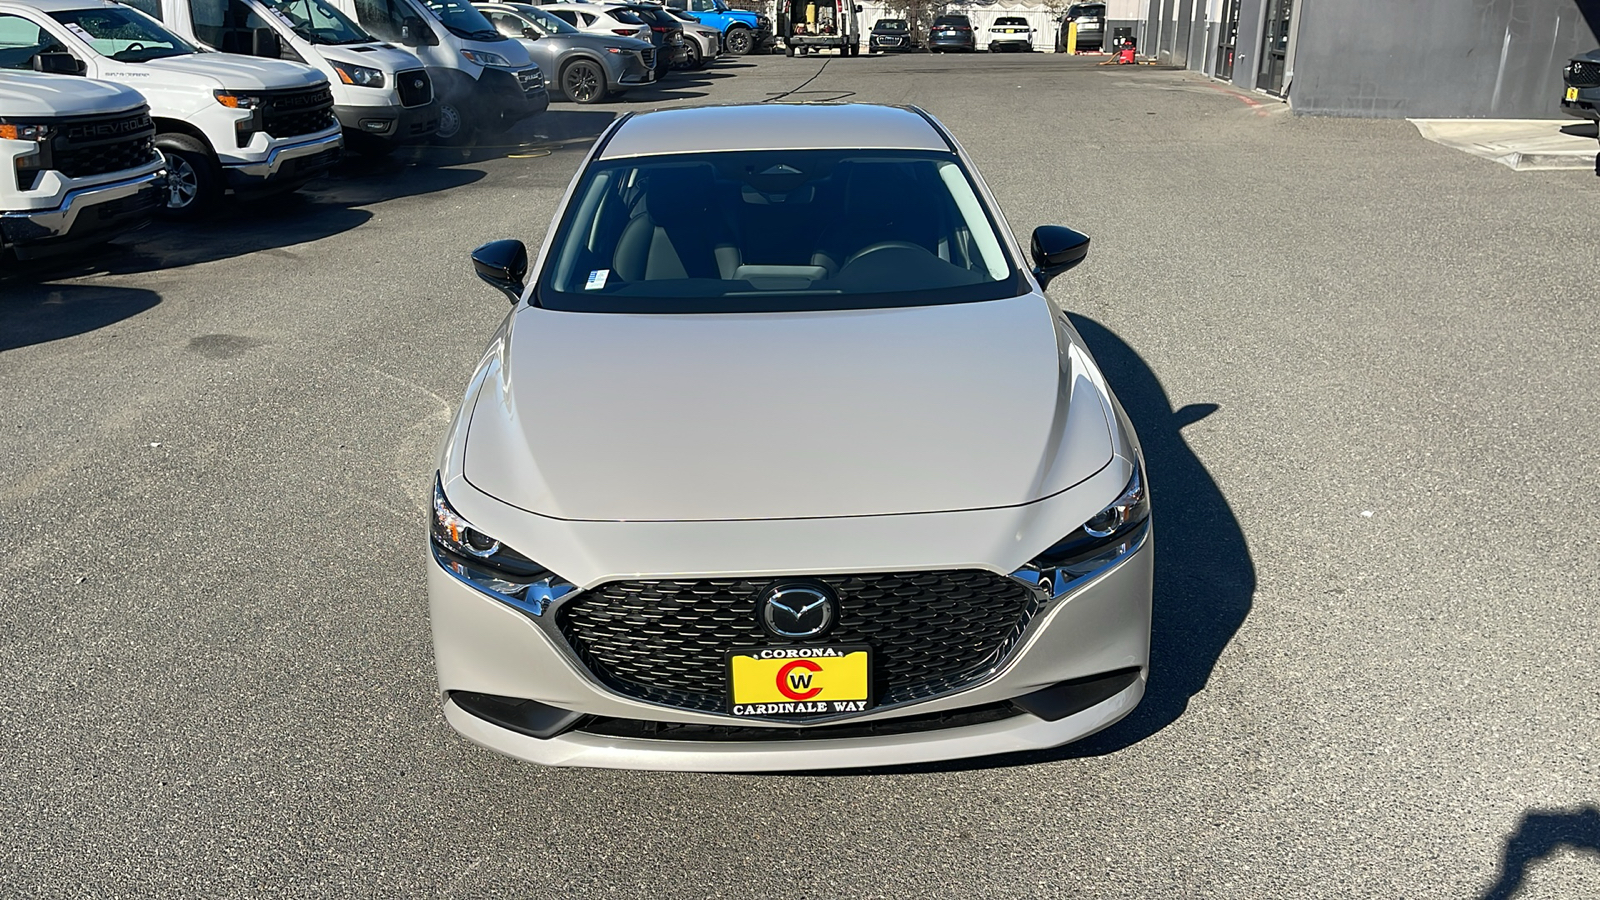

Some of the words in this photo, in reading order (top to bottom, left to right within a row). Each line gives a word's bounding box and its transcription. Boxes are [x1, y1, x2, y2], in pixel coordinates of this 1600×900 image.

[276, 91, 331, 107] CHEVROLE
[761, 647, 837, 659] CORONA
[776, 659, 823, 701] C
[789, 674, 813, 689] W
[733, 702, 827, 716] CARDINALE
[834, 701, 867, 712] WAY
